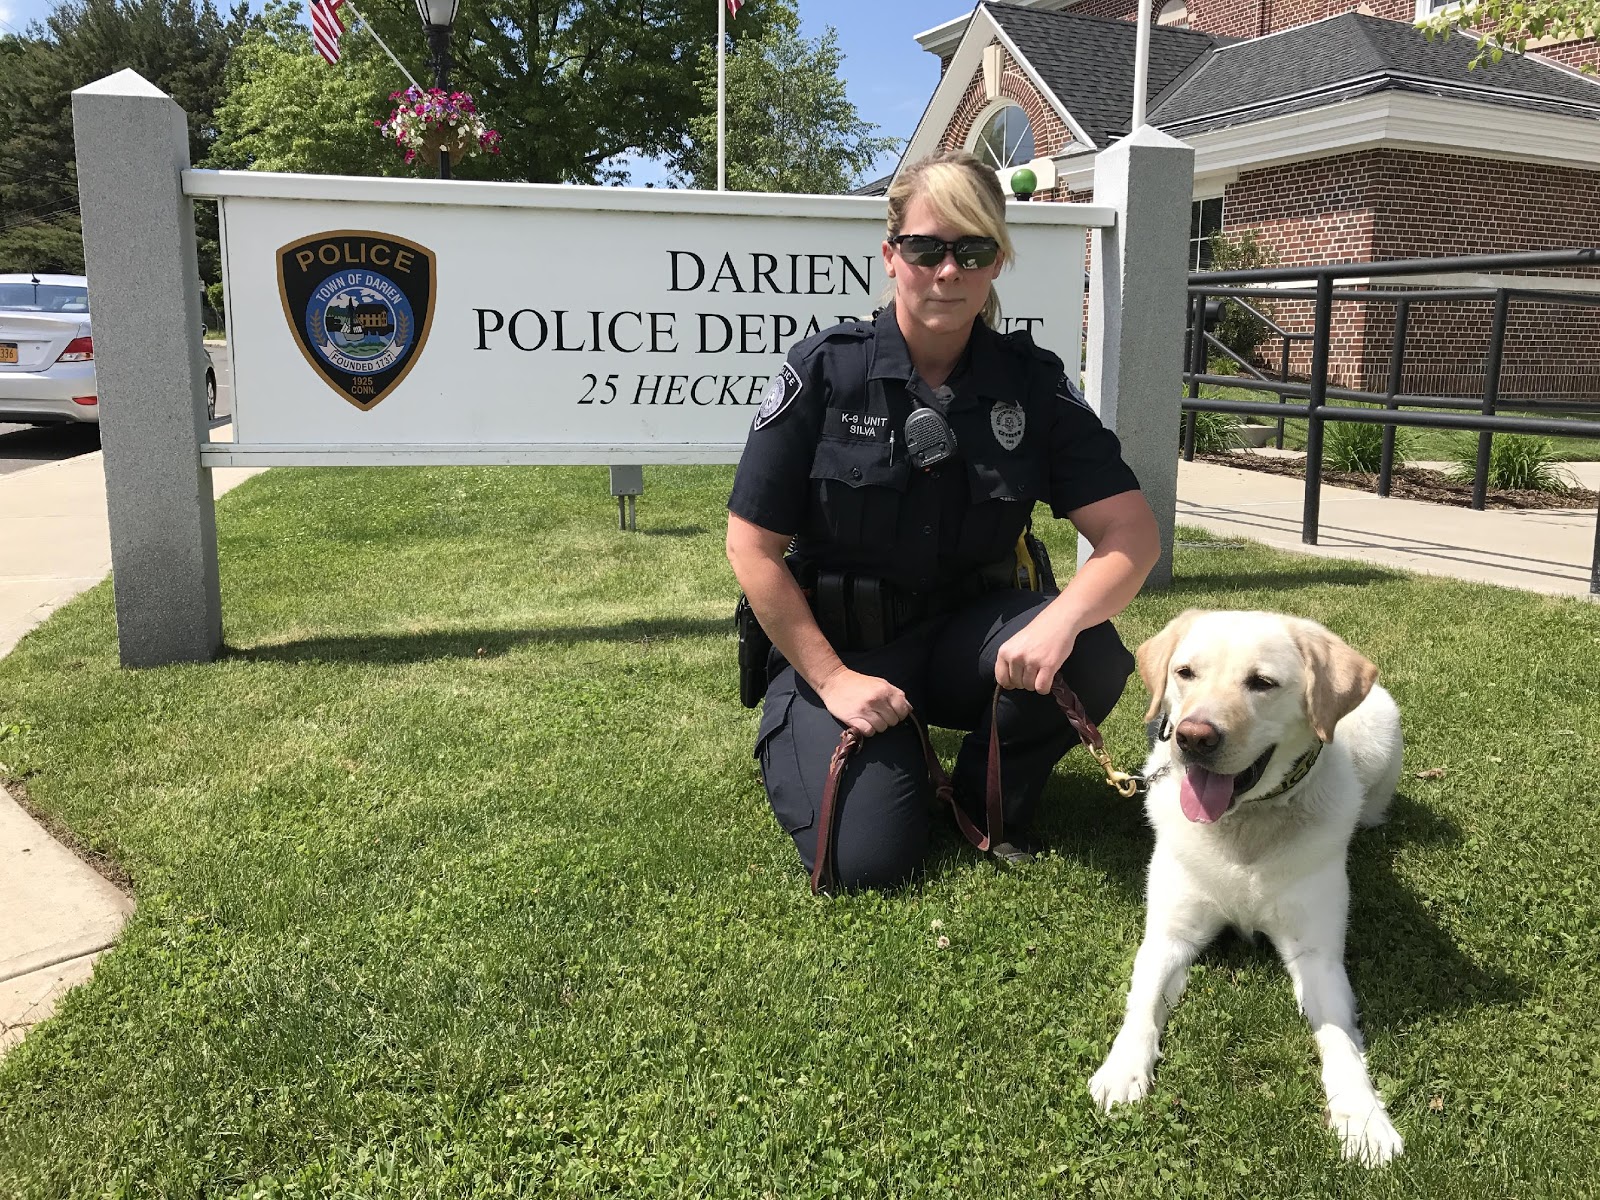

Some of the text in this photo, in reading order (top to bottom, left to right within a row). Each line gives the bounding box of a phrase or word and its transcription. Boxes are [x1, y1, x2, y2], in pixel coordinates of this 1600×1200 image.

[295, 242, 415, 274] POLICE
[666, 250, 876, 296] DARIEN
[315, 273, 403, 305] TOWN OF DARIEN
[472, 308, 678, 354] POLICE
[331, 354, 394, 372] FOUNDED 1737
[351, 385, 377, 395] CONN.
[352, 376, 373, 386] 1925
[577, 373, 620, 405] 25
[630, 374, 779, 406] HECKE
[841, 413, 888, 427] K-9 UNIT
[849, 424, 876, 437] SILVA
